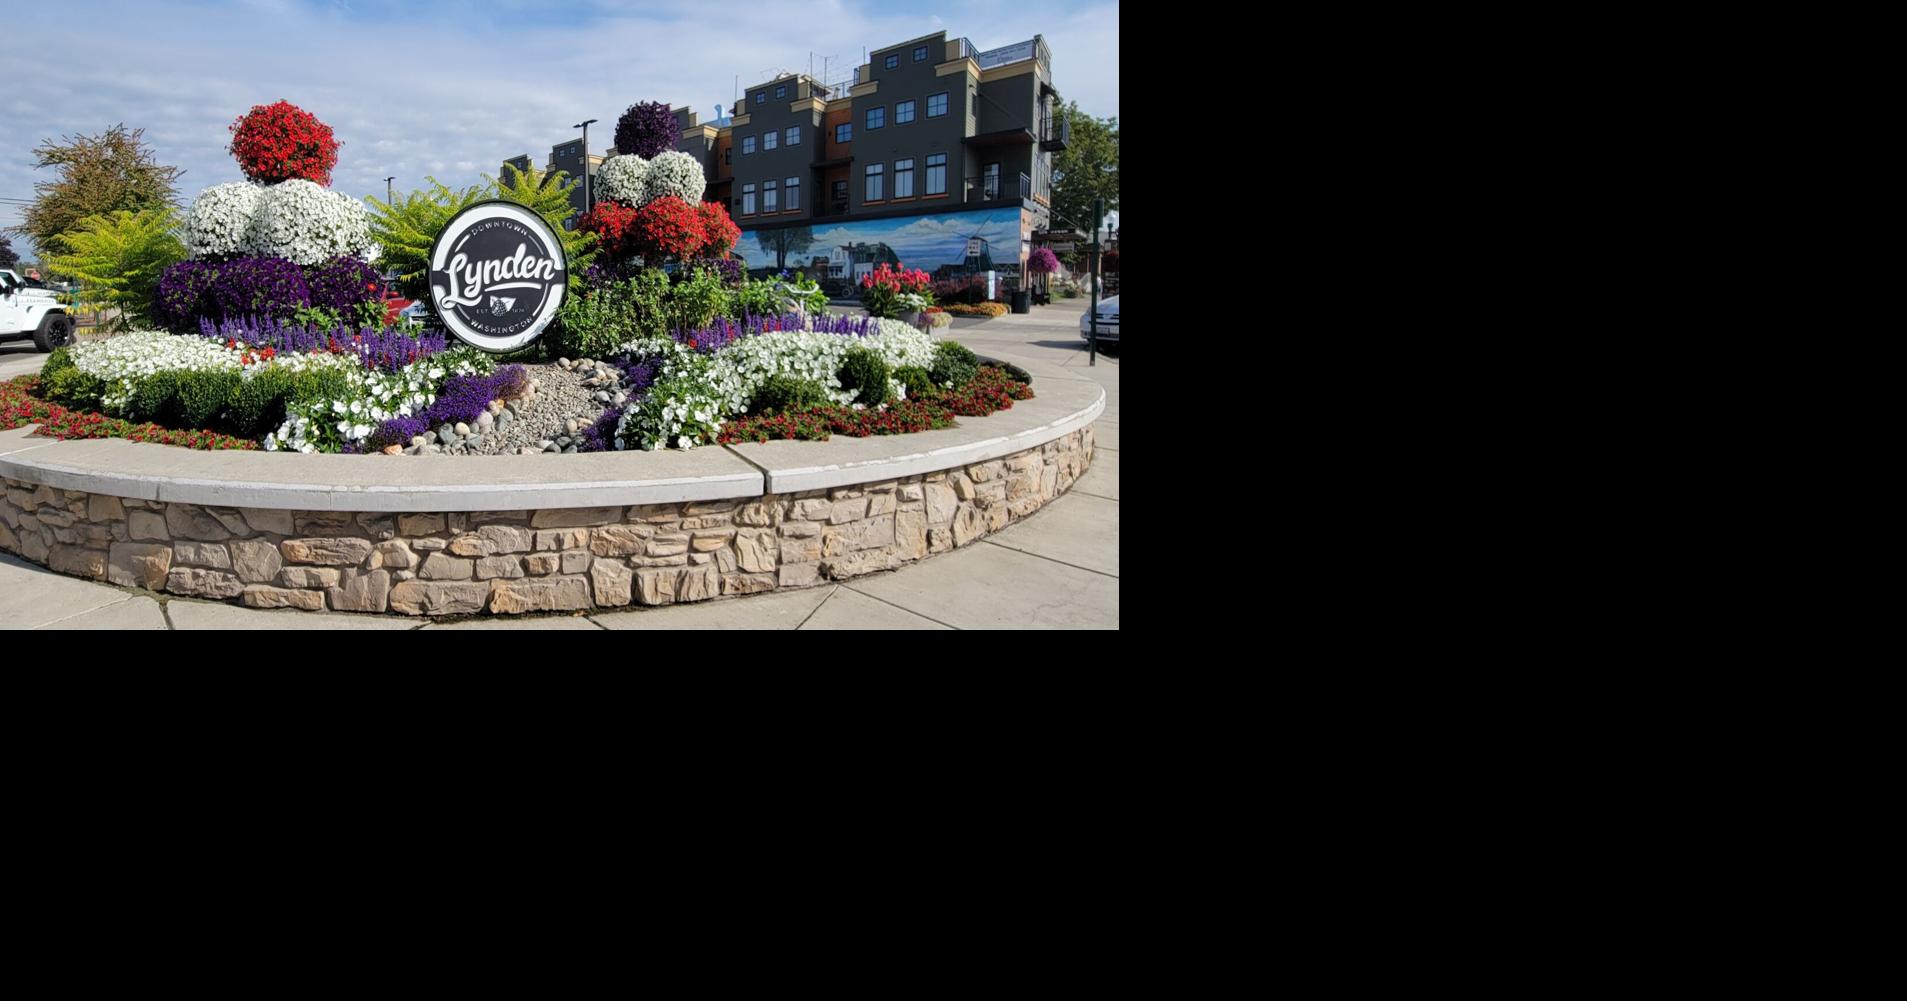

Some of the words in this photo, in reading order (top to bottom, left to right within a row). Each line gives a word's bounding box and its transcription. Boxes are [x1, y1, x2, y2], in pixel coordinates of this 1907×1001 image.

[471, 220, 528, 236] DOWNTOWN
[441, 243, 555, 309] Lynden
[470, 317, 533, 334] WASHINGTON
